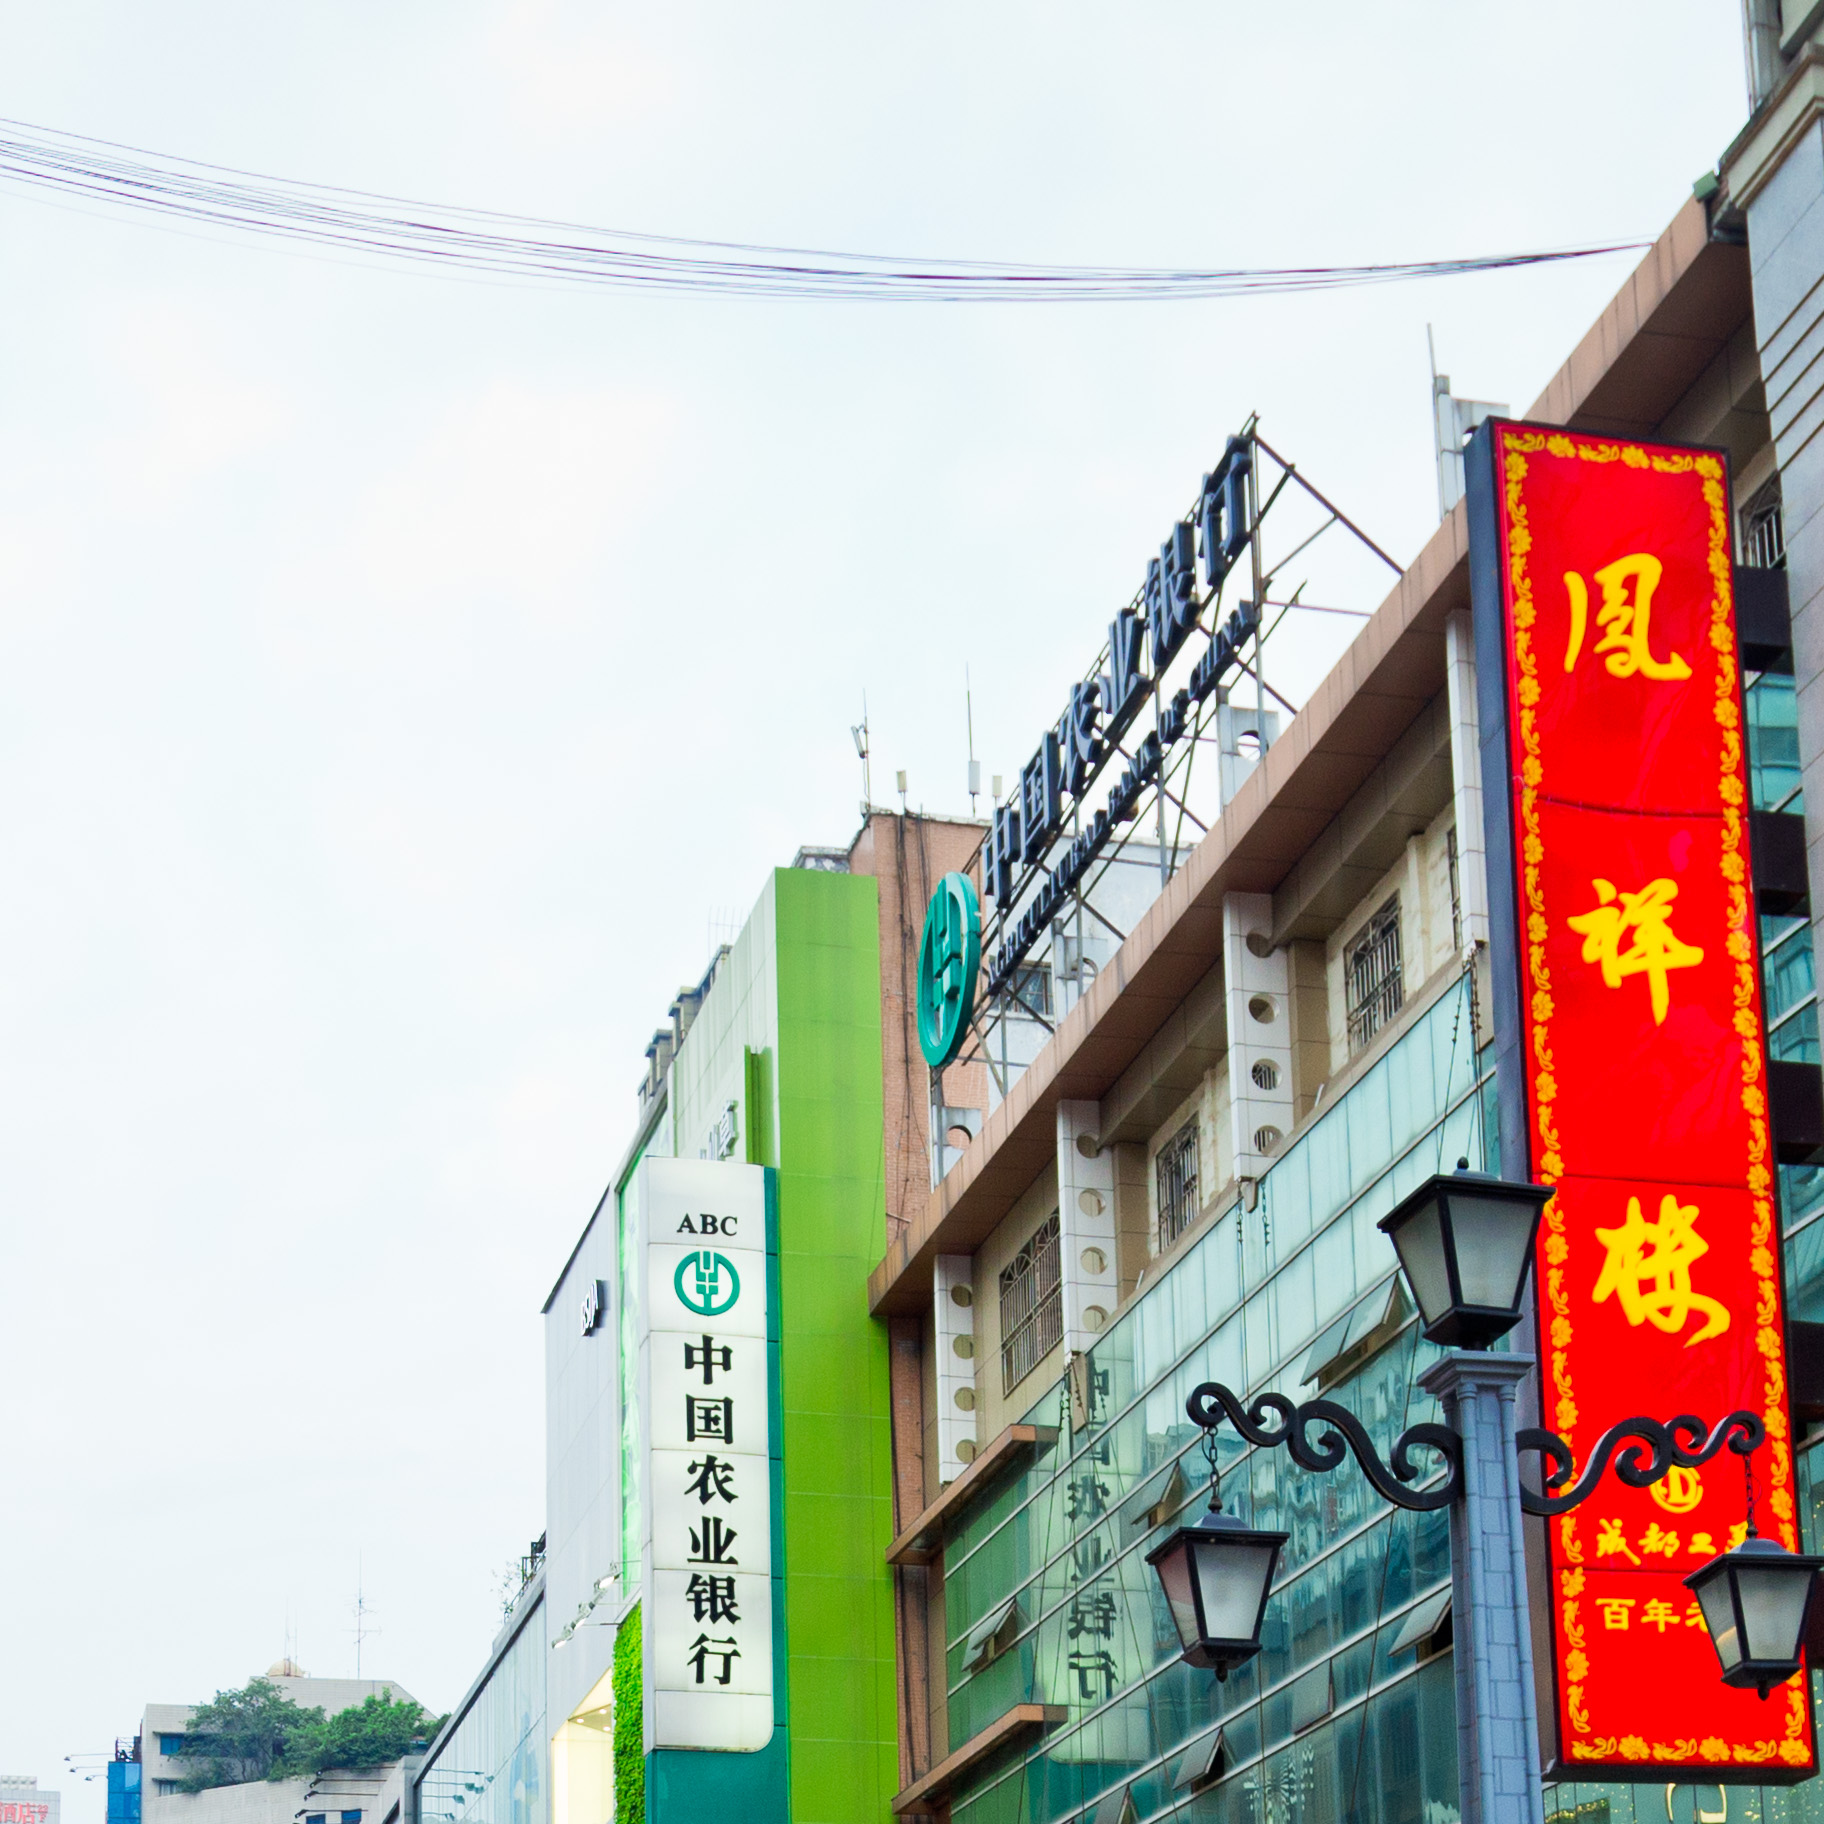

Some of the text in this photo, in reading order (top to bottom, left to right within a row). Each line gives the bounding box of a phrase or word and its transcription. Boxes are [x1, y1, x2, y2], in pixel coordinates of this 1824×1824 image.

[676, 1213, 738, 1237] ABC
[683, 1334, 742, 1686] 中国农业银行
